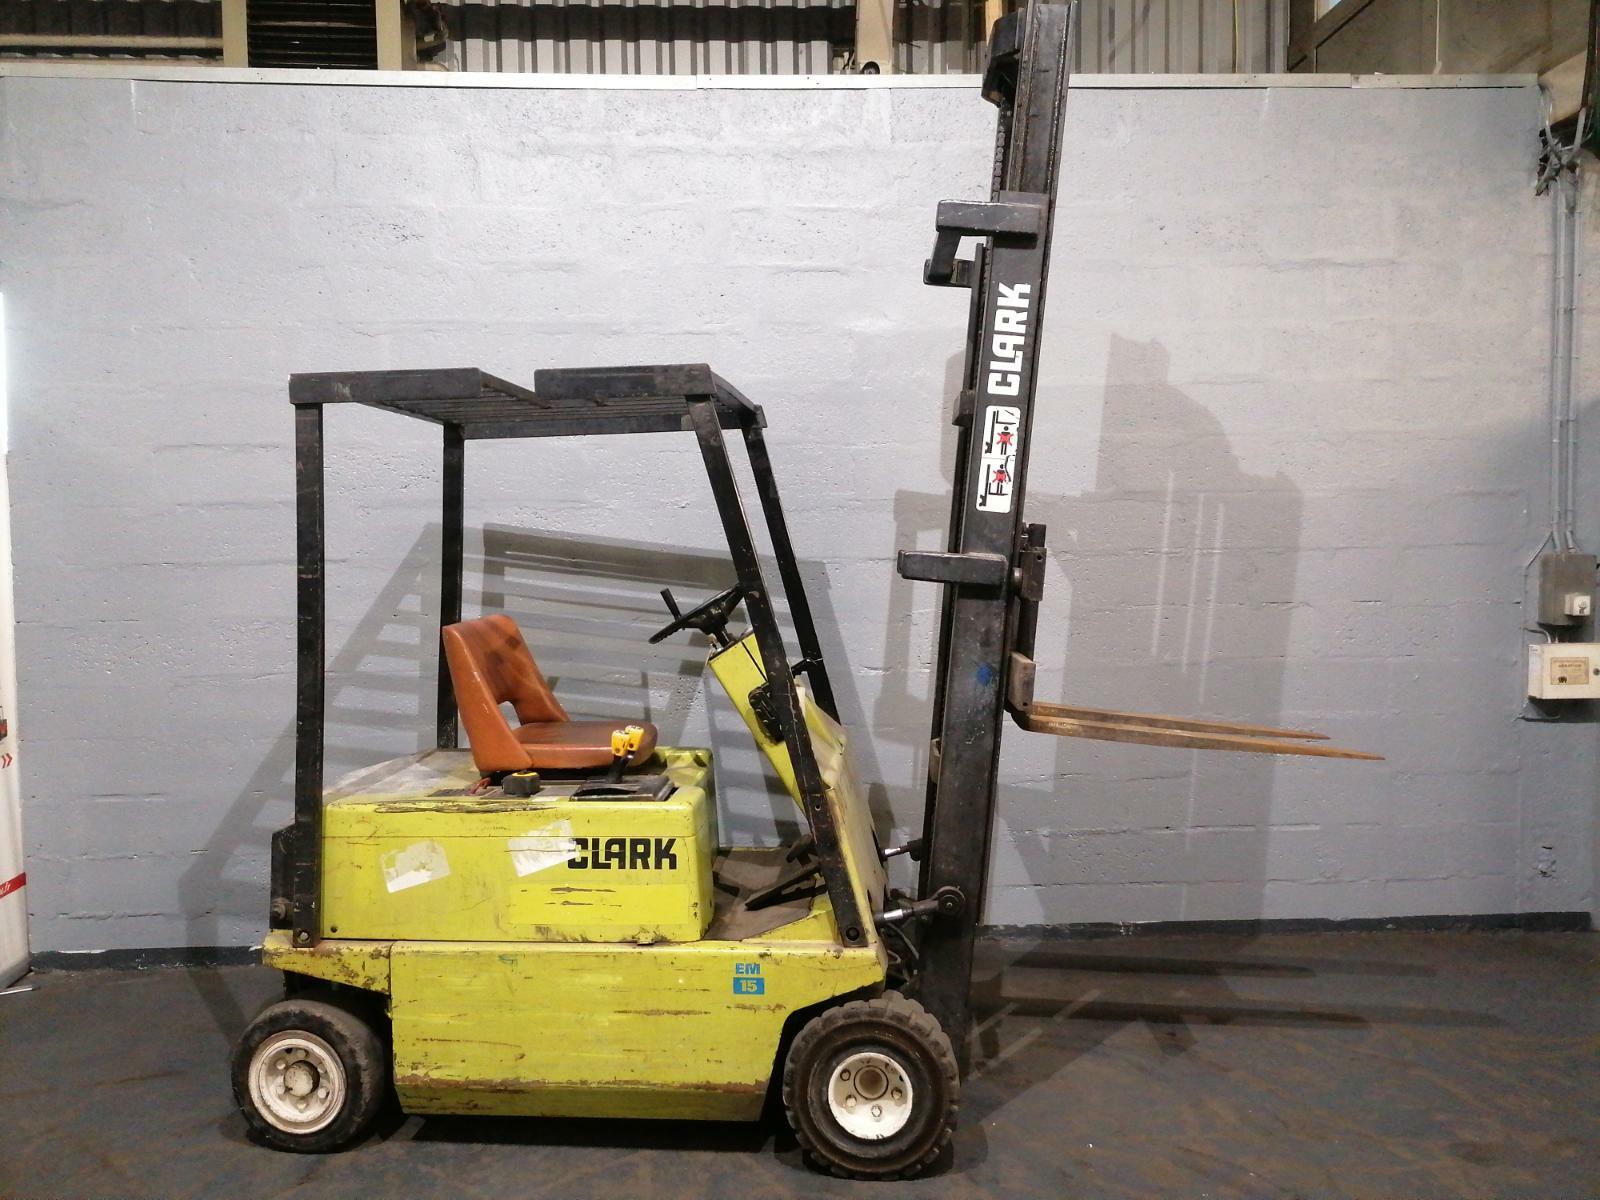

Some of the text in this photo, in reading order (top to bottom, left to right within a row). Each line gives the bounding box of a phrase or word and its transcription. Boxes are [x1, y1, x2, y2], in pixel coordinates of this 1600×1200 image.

[987, 282, 1032, 396] CLARK
[736, 963, 760, 974] EM
[740, 980, 757, 992] 15
